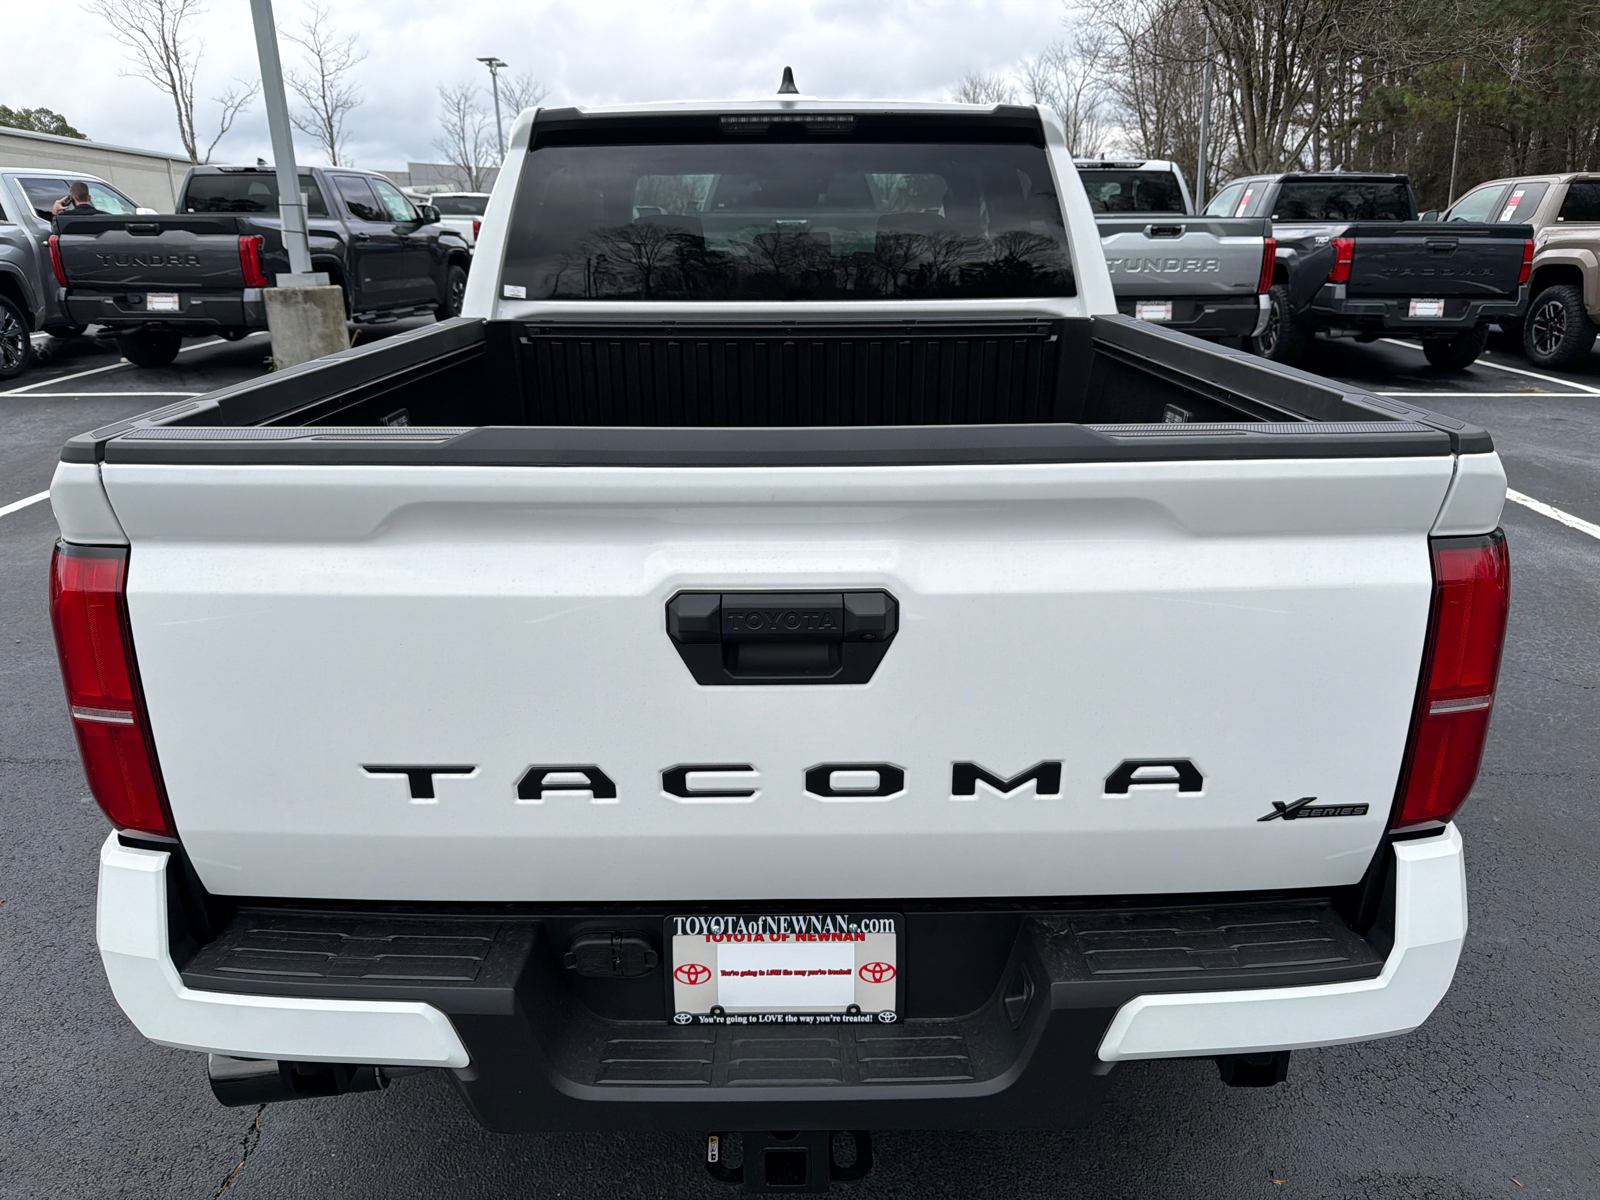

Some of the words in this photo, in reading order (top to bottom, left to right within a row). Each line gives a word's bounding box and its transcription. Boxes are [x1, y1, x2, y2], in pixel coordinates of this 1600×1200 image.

[96, 253, 201, 267] TUNDRA
[1106, 258, 1220, 273] TUNDRA
[1381, 268, 1494, 276] TACOMA
[728, 611, 838, 631] TOYOTA
[360, 758, 1206, 803] TACOMA
[726, 1016, 748, 1024] going
[758, 1014, 784, 1022] LOVE
[785, 1014, 798, 1022] the
[799, 1016, 814, 1024] way
[816, 1014, 841, 1024] you're
[842, 1014, 873, 1022] treated!
